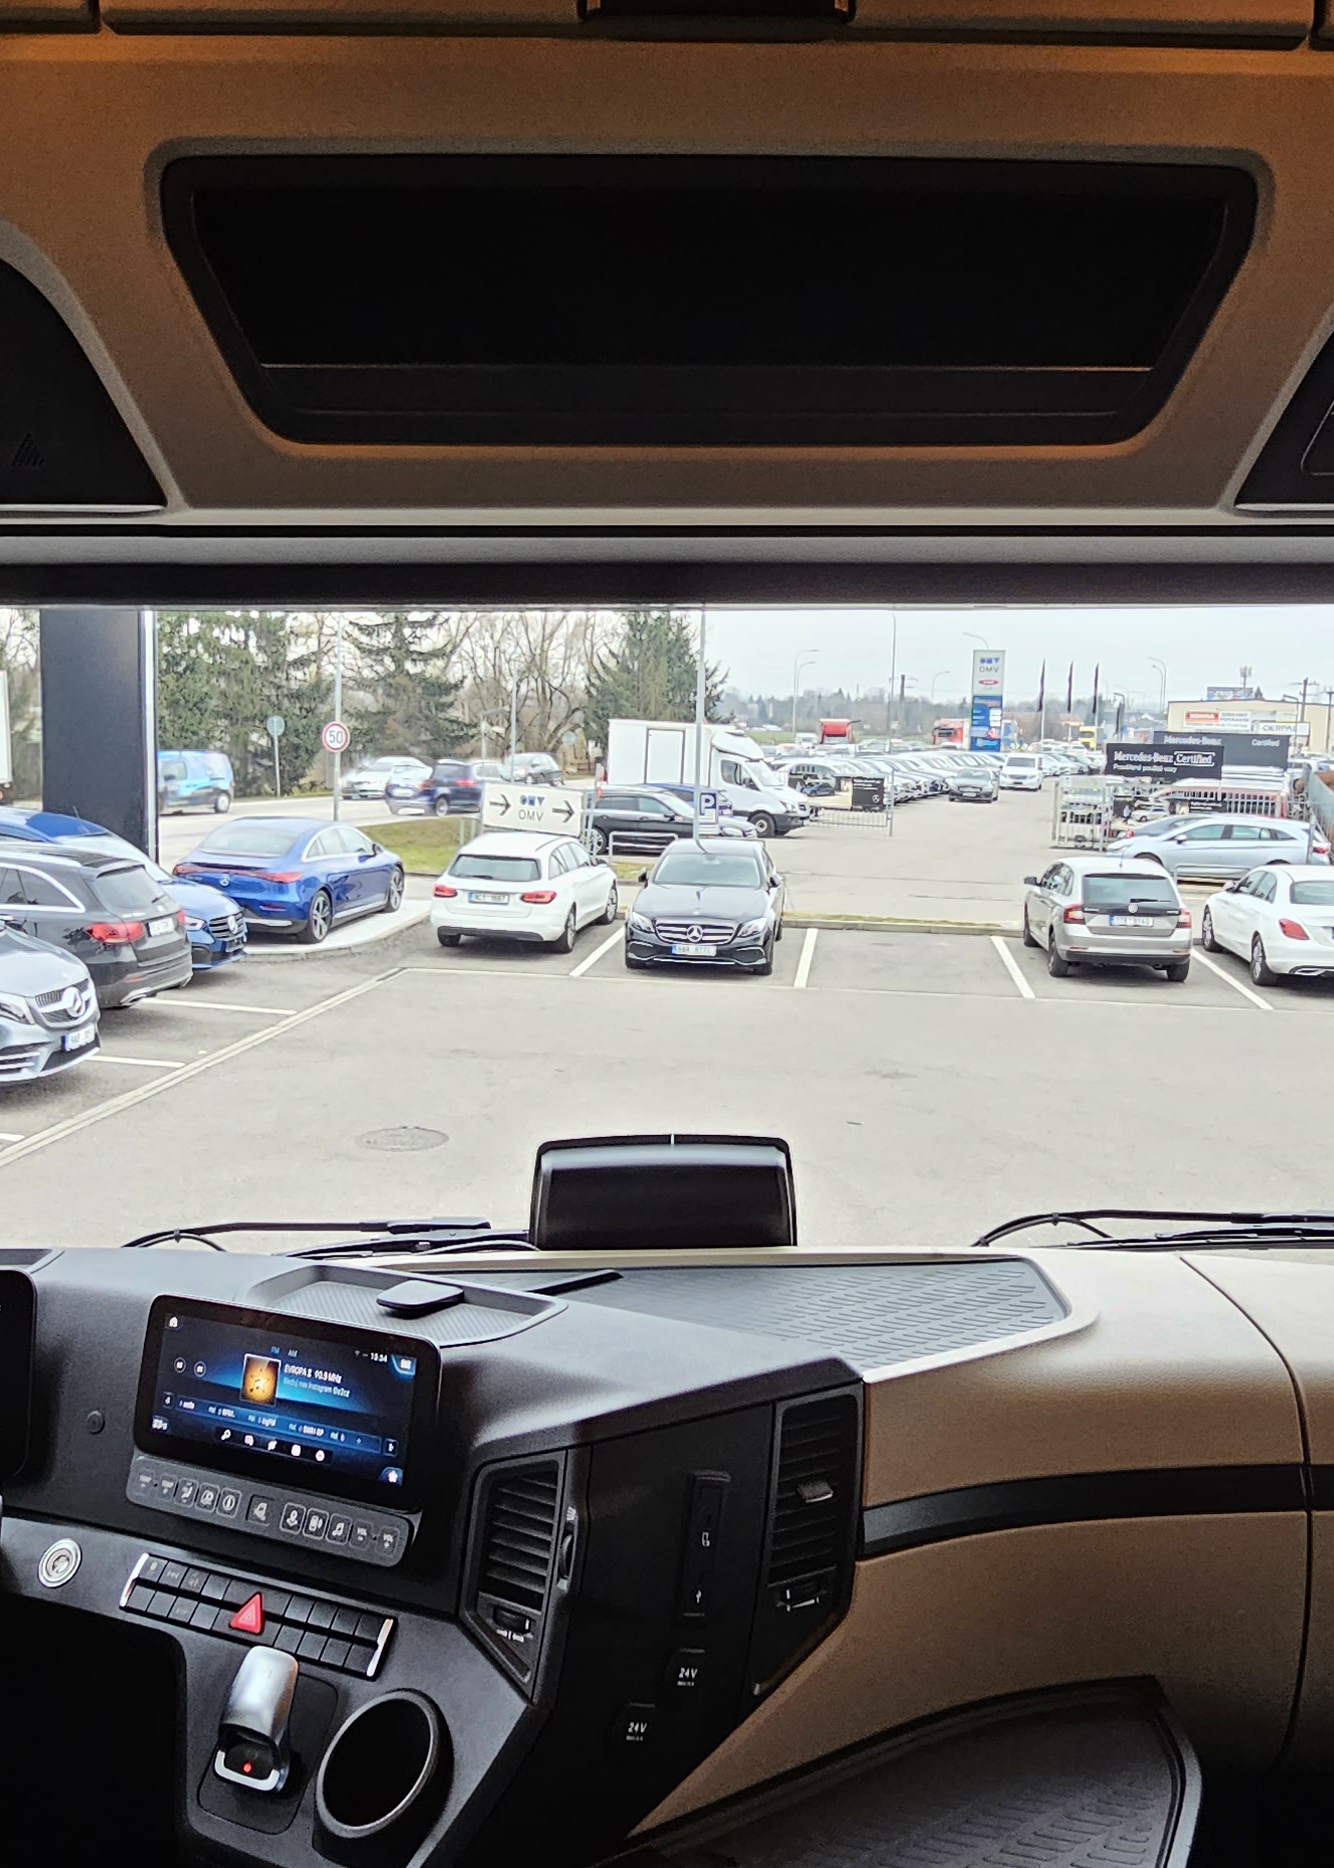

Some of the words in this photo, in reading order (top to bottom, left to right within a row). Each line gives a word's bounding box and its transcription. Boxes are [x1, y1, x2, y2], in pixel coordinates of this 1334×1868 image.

[329, 730, 343, 744] 50
[1114, 751, 1174, 763] Mercedes-Benz
[1176, 753, 1213, 764] Certified
[700, 794, 715, 816] P
[518, 809, 544, 822] OMV
[678, 1667, 698, 1679] 24V
[628, 1721, 648, 1733] 24V
